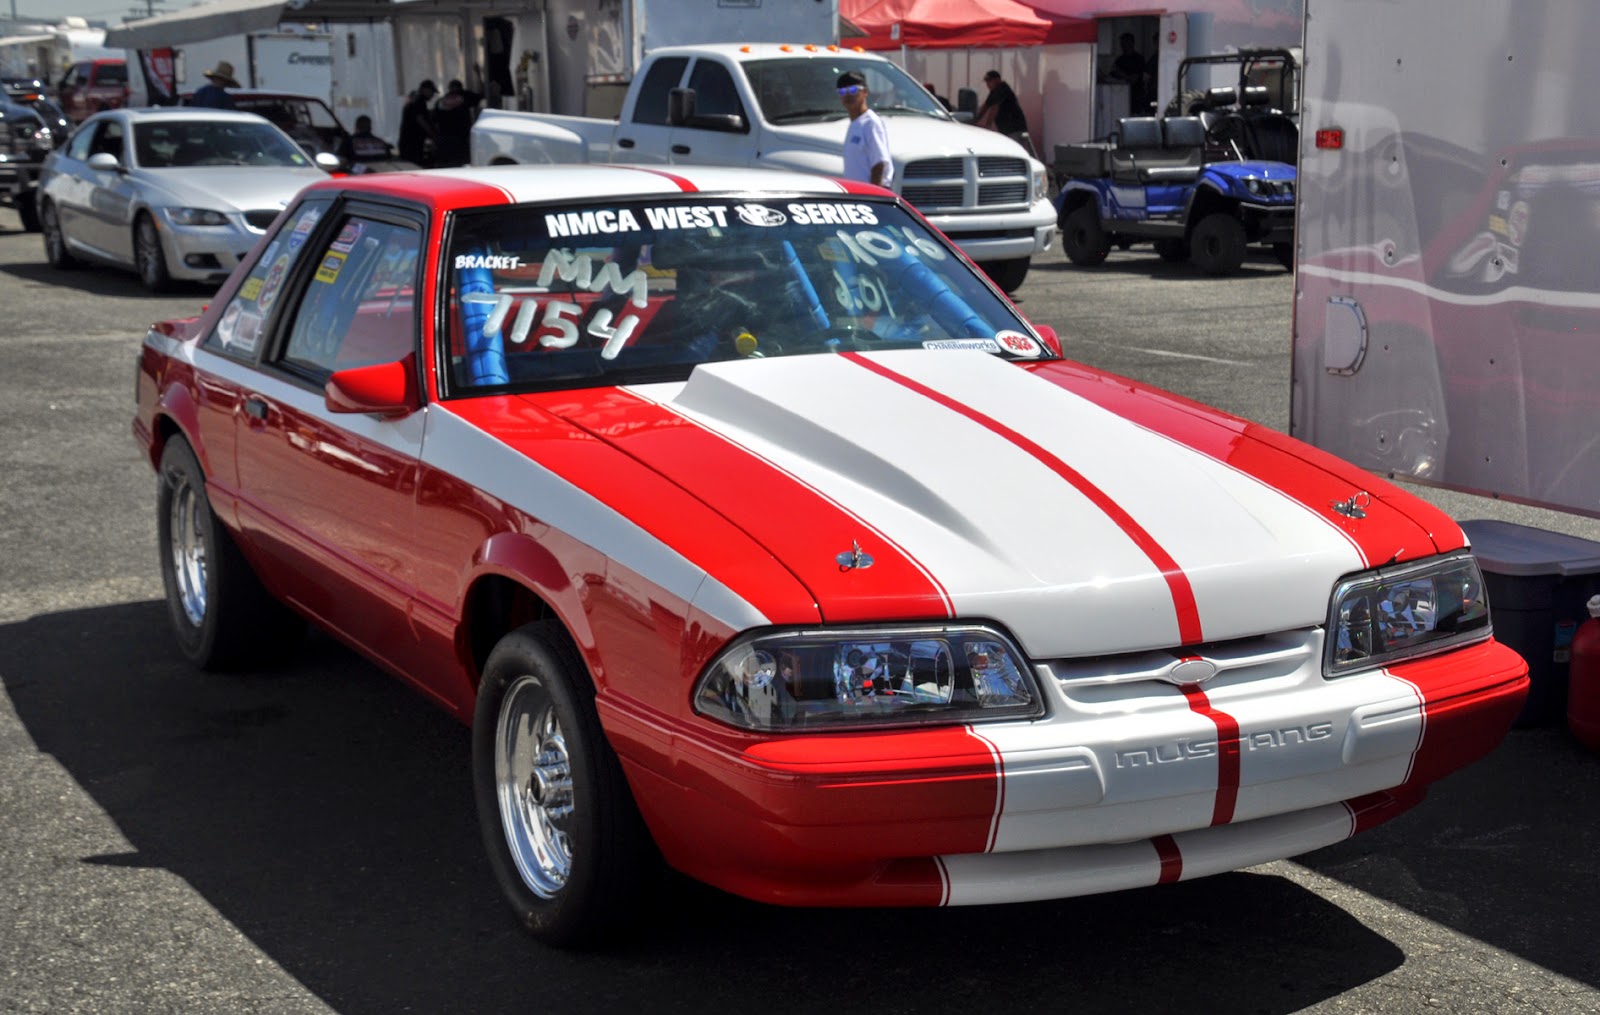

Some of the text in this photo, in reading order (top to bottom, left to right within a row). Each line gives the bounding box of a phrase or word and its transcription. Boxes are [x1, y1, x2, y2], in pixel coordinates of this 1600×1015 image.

[545, 208, 641, 238] NMCA
[644, 205, 728, 231] WEST
[787, 203, 879, 225] SERIES
[461, 292, 640, 360] 7154
[1115, 721, 1333, 769] MUSTANG
